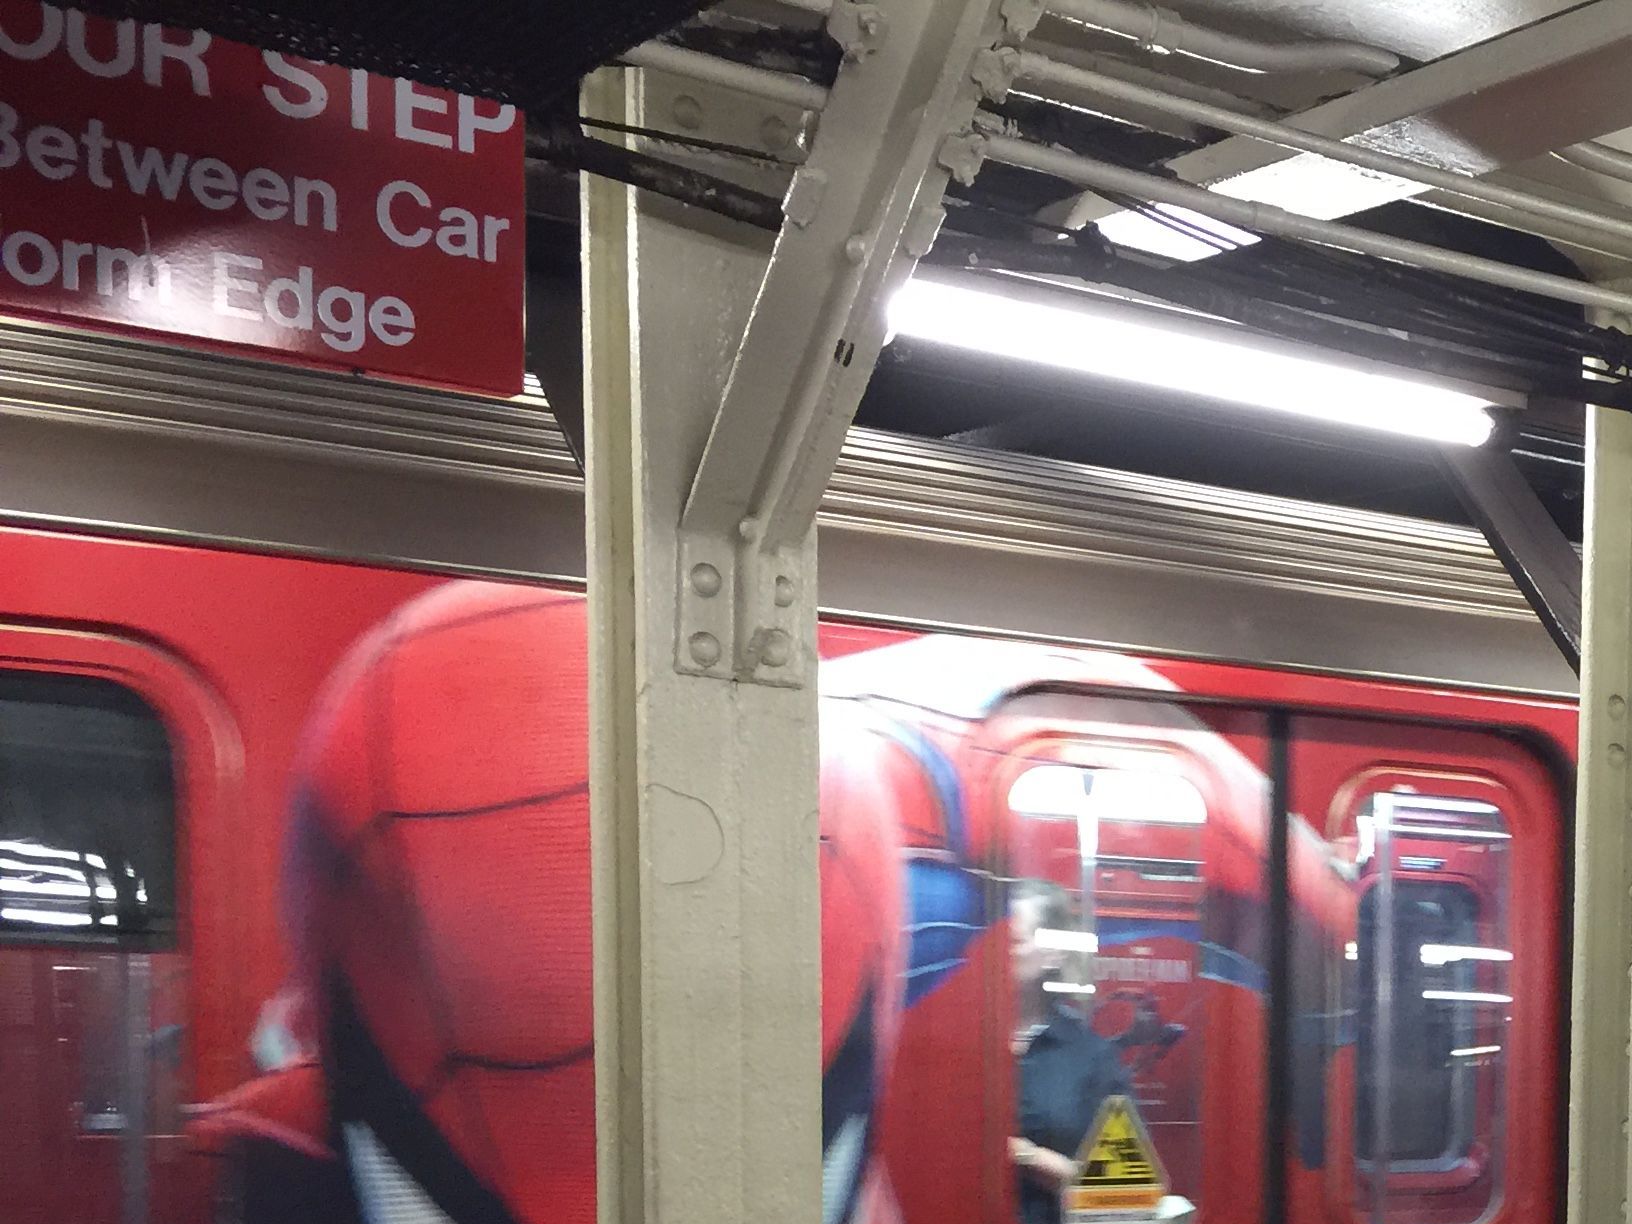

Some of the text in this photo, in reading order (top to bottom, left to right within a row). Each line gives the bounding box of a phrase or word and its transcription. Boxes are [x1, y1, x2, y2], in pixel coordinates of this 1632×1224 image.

[262, 49, 516, 154] STEP
[376, 180, 510, 262] Car
[213, 250, 416, 352] Edge
